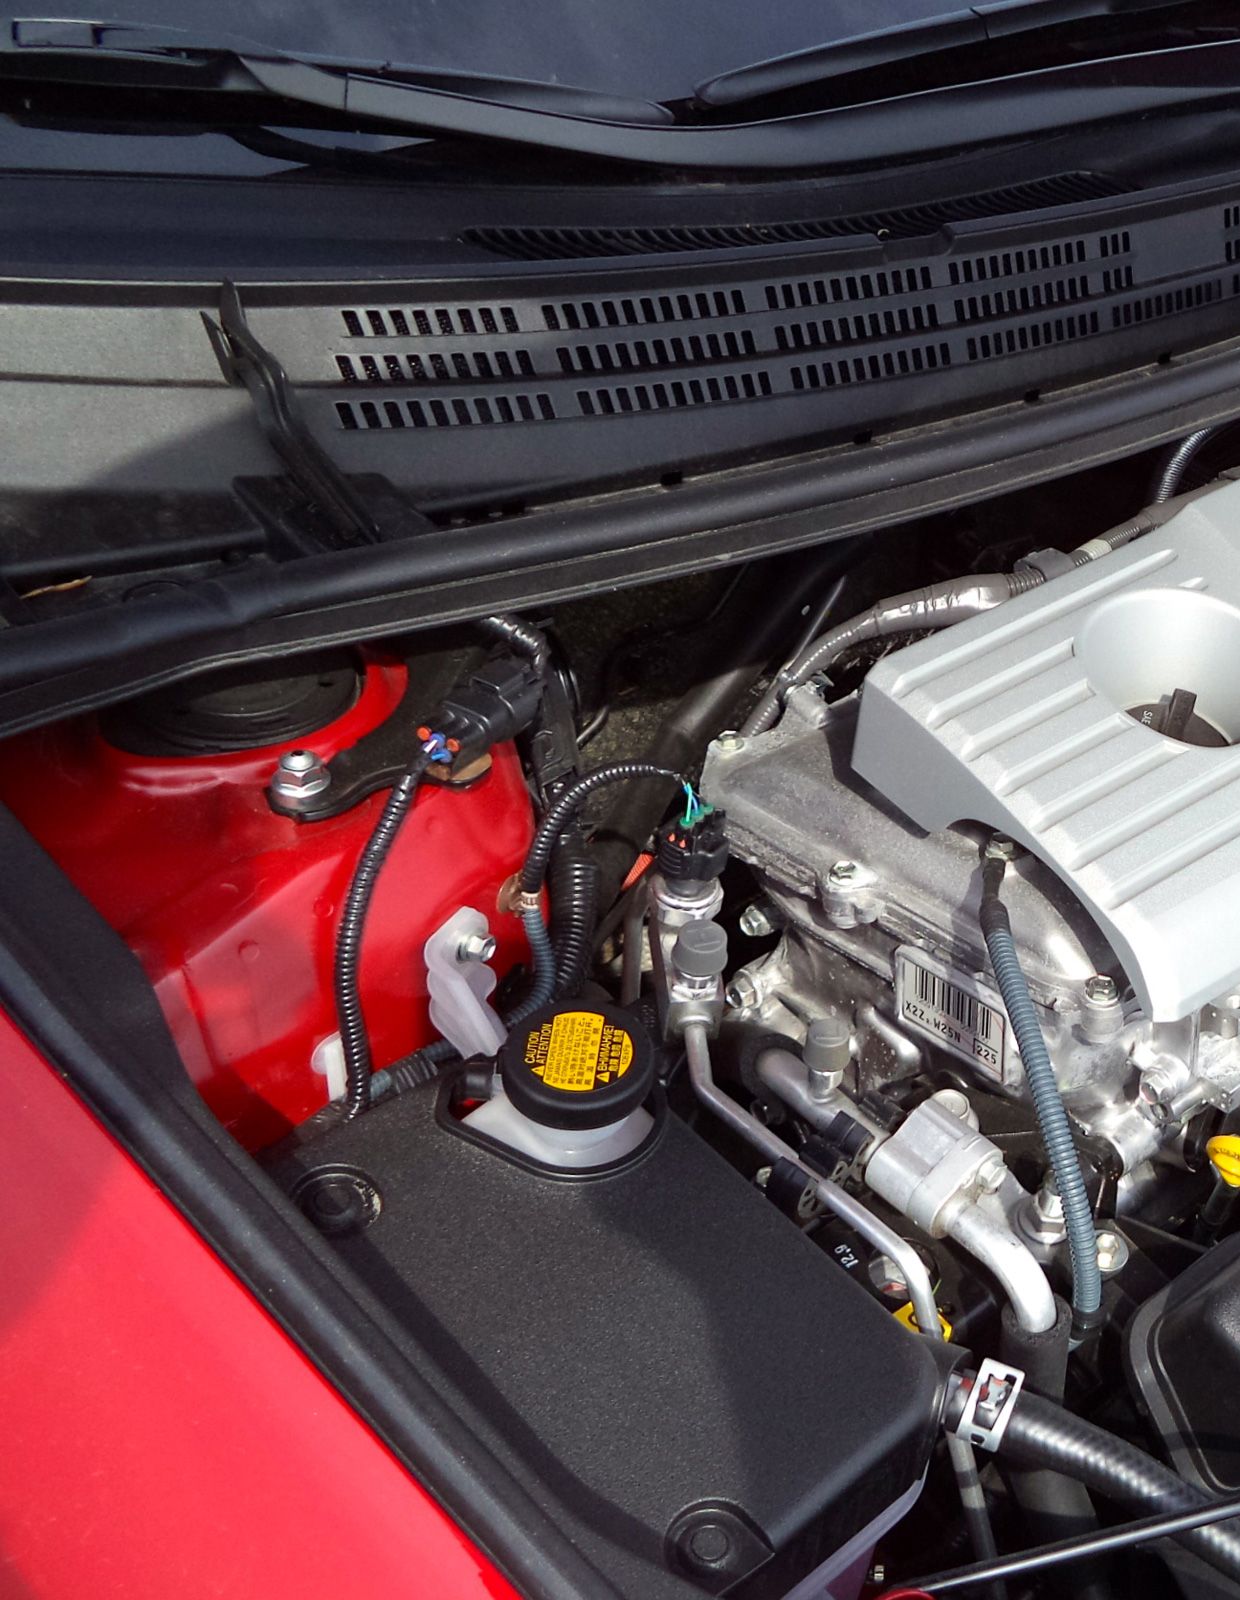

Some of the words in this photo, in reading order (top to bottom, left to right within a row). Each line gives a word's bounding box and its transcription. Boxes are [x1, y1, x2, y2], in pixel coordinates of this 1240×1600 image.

[524, 1032, 539, 1064] CAUTION
[536, 1024, 552, 1064] ATTENTION
[976, 1044, 998, 1065] 225
